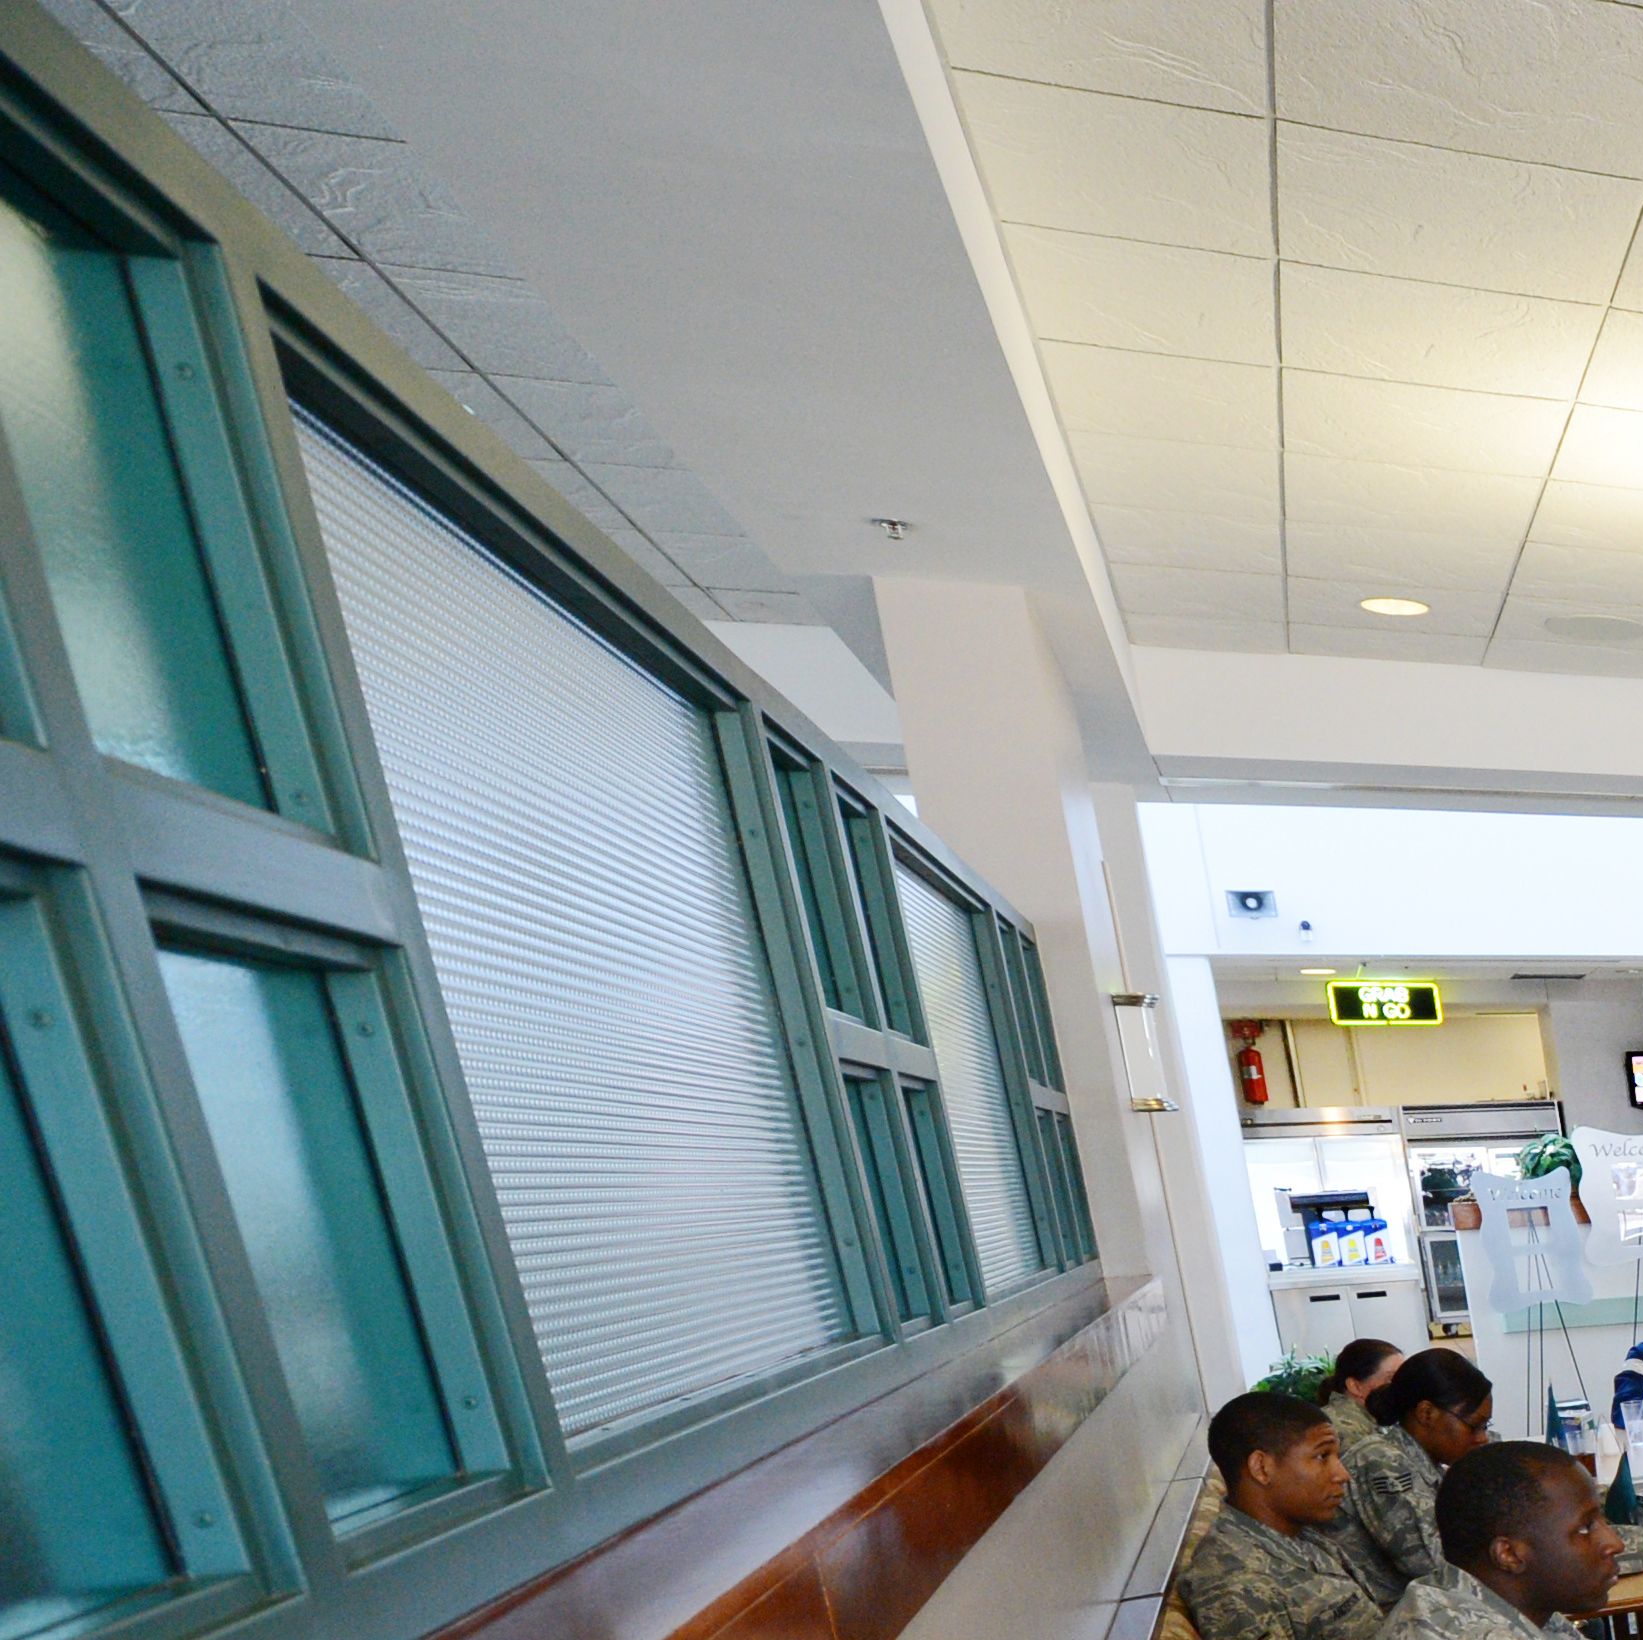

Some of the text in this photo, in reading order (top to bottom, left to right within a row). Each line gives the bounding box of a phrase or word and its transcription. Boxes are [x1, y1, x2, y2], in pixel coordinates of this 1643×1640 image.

[1358, 986, 1410, 1003] GRAB
[1362, 1002, 1411, 1019] N GO
[1487, 1186, 1562, 1201] Welcome
